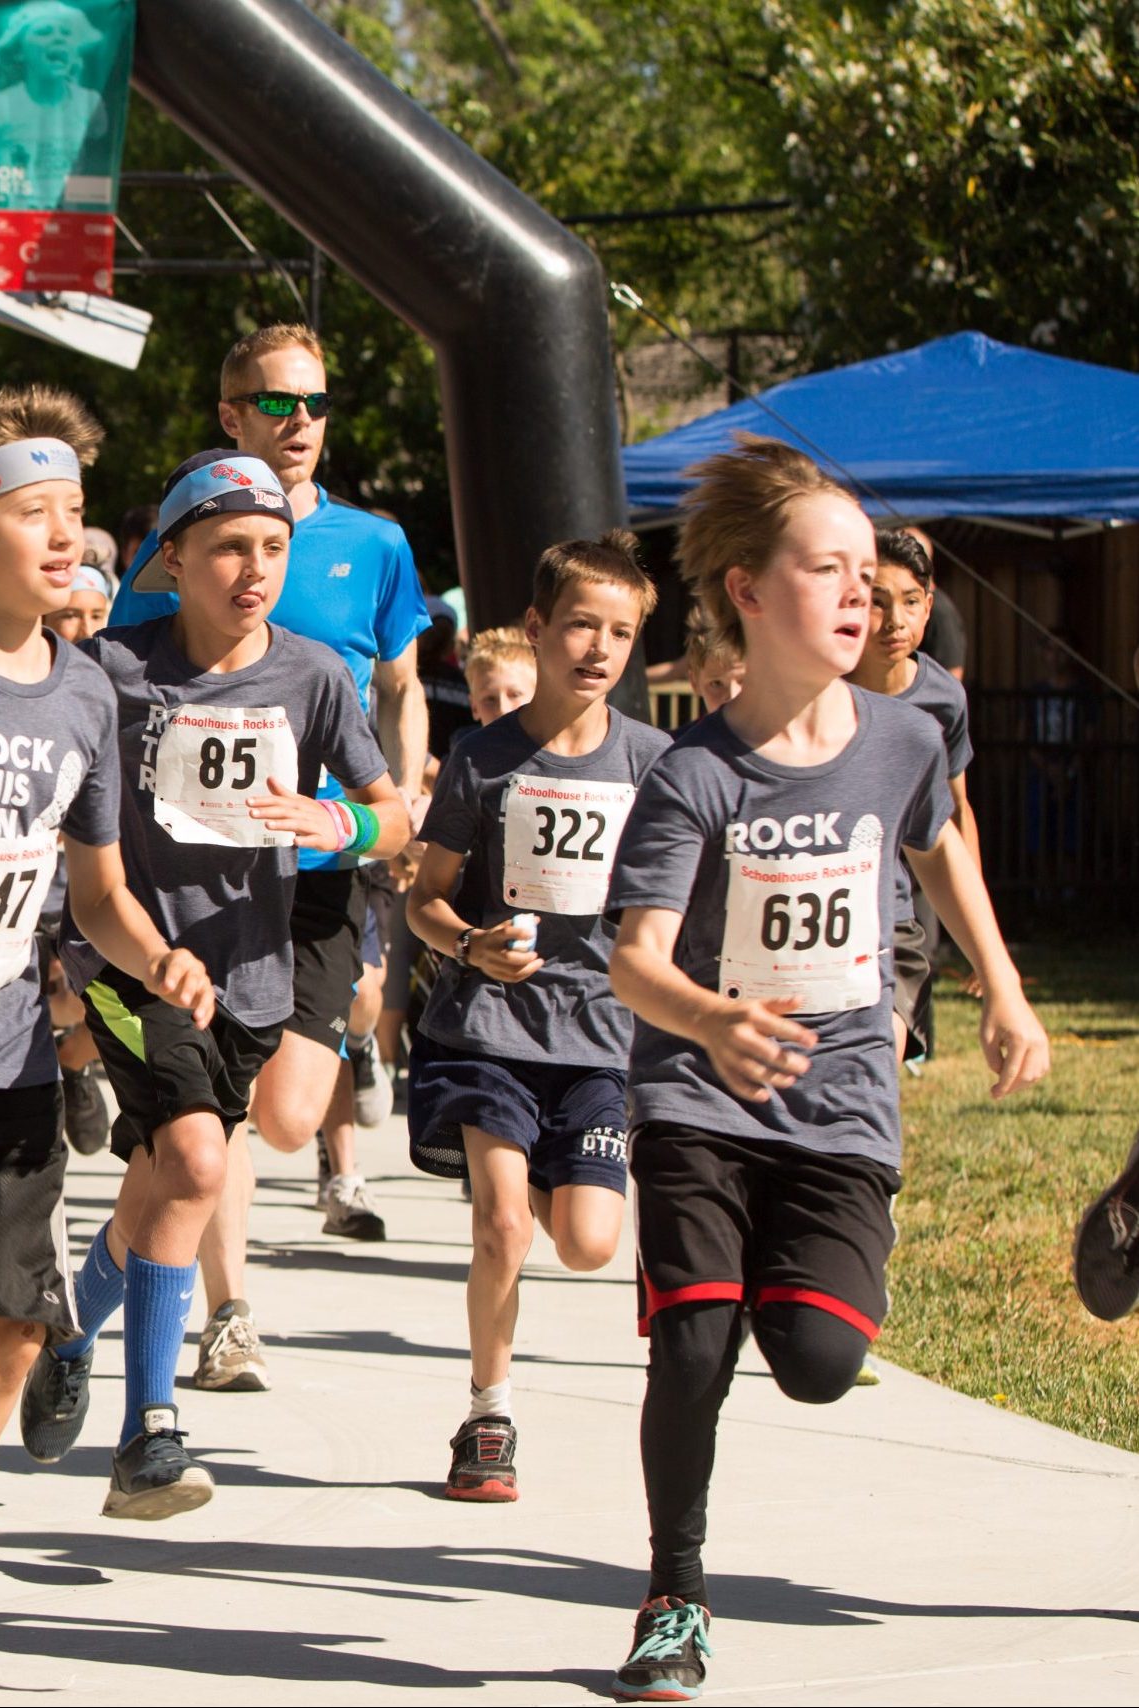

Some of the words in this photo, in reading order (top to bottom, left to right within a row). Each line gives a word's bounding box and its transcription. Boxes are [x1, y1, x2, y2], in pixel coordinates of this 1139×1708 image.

[243, 718, 275, 729] Rocks
[199, 737, 258, 790] 85
[518, 785, 581, 801] Schoolhouse
[532, 806, 606, 861] 322
[725, 812, 842, 852] ROCK
[741, 865, 818, 883] Schoolhouse
[822, 866, 857, 879] Rocks
[860, 861, 874, 874] 5K
[762, 887, 851, 951] 636
[582, 1133, 628, 1160] OTTE
